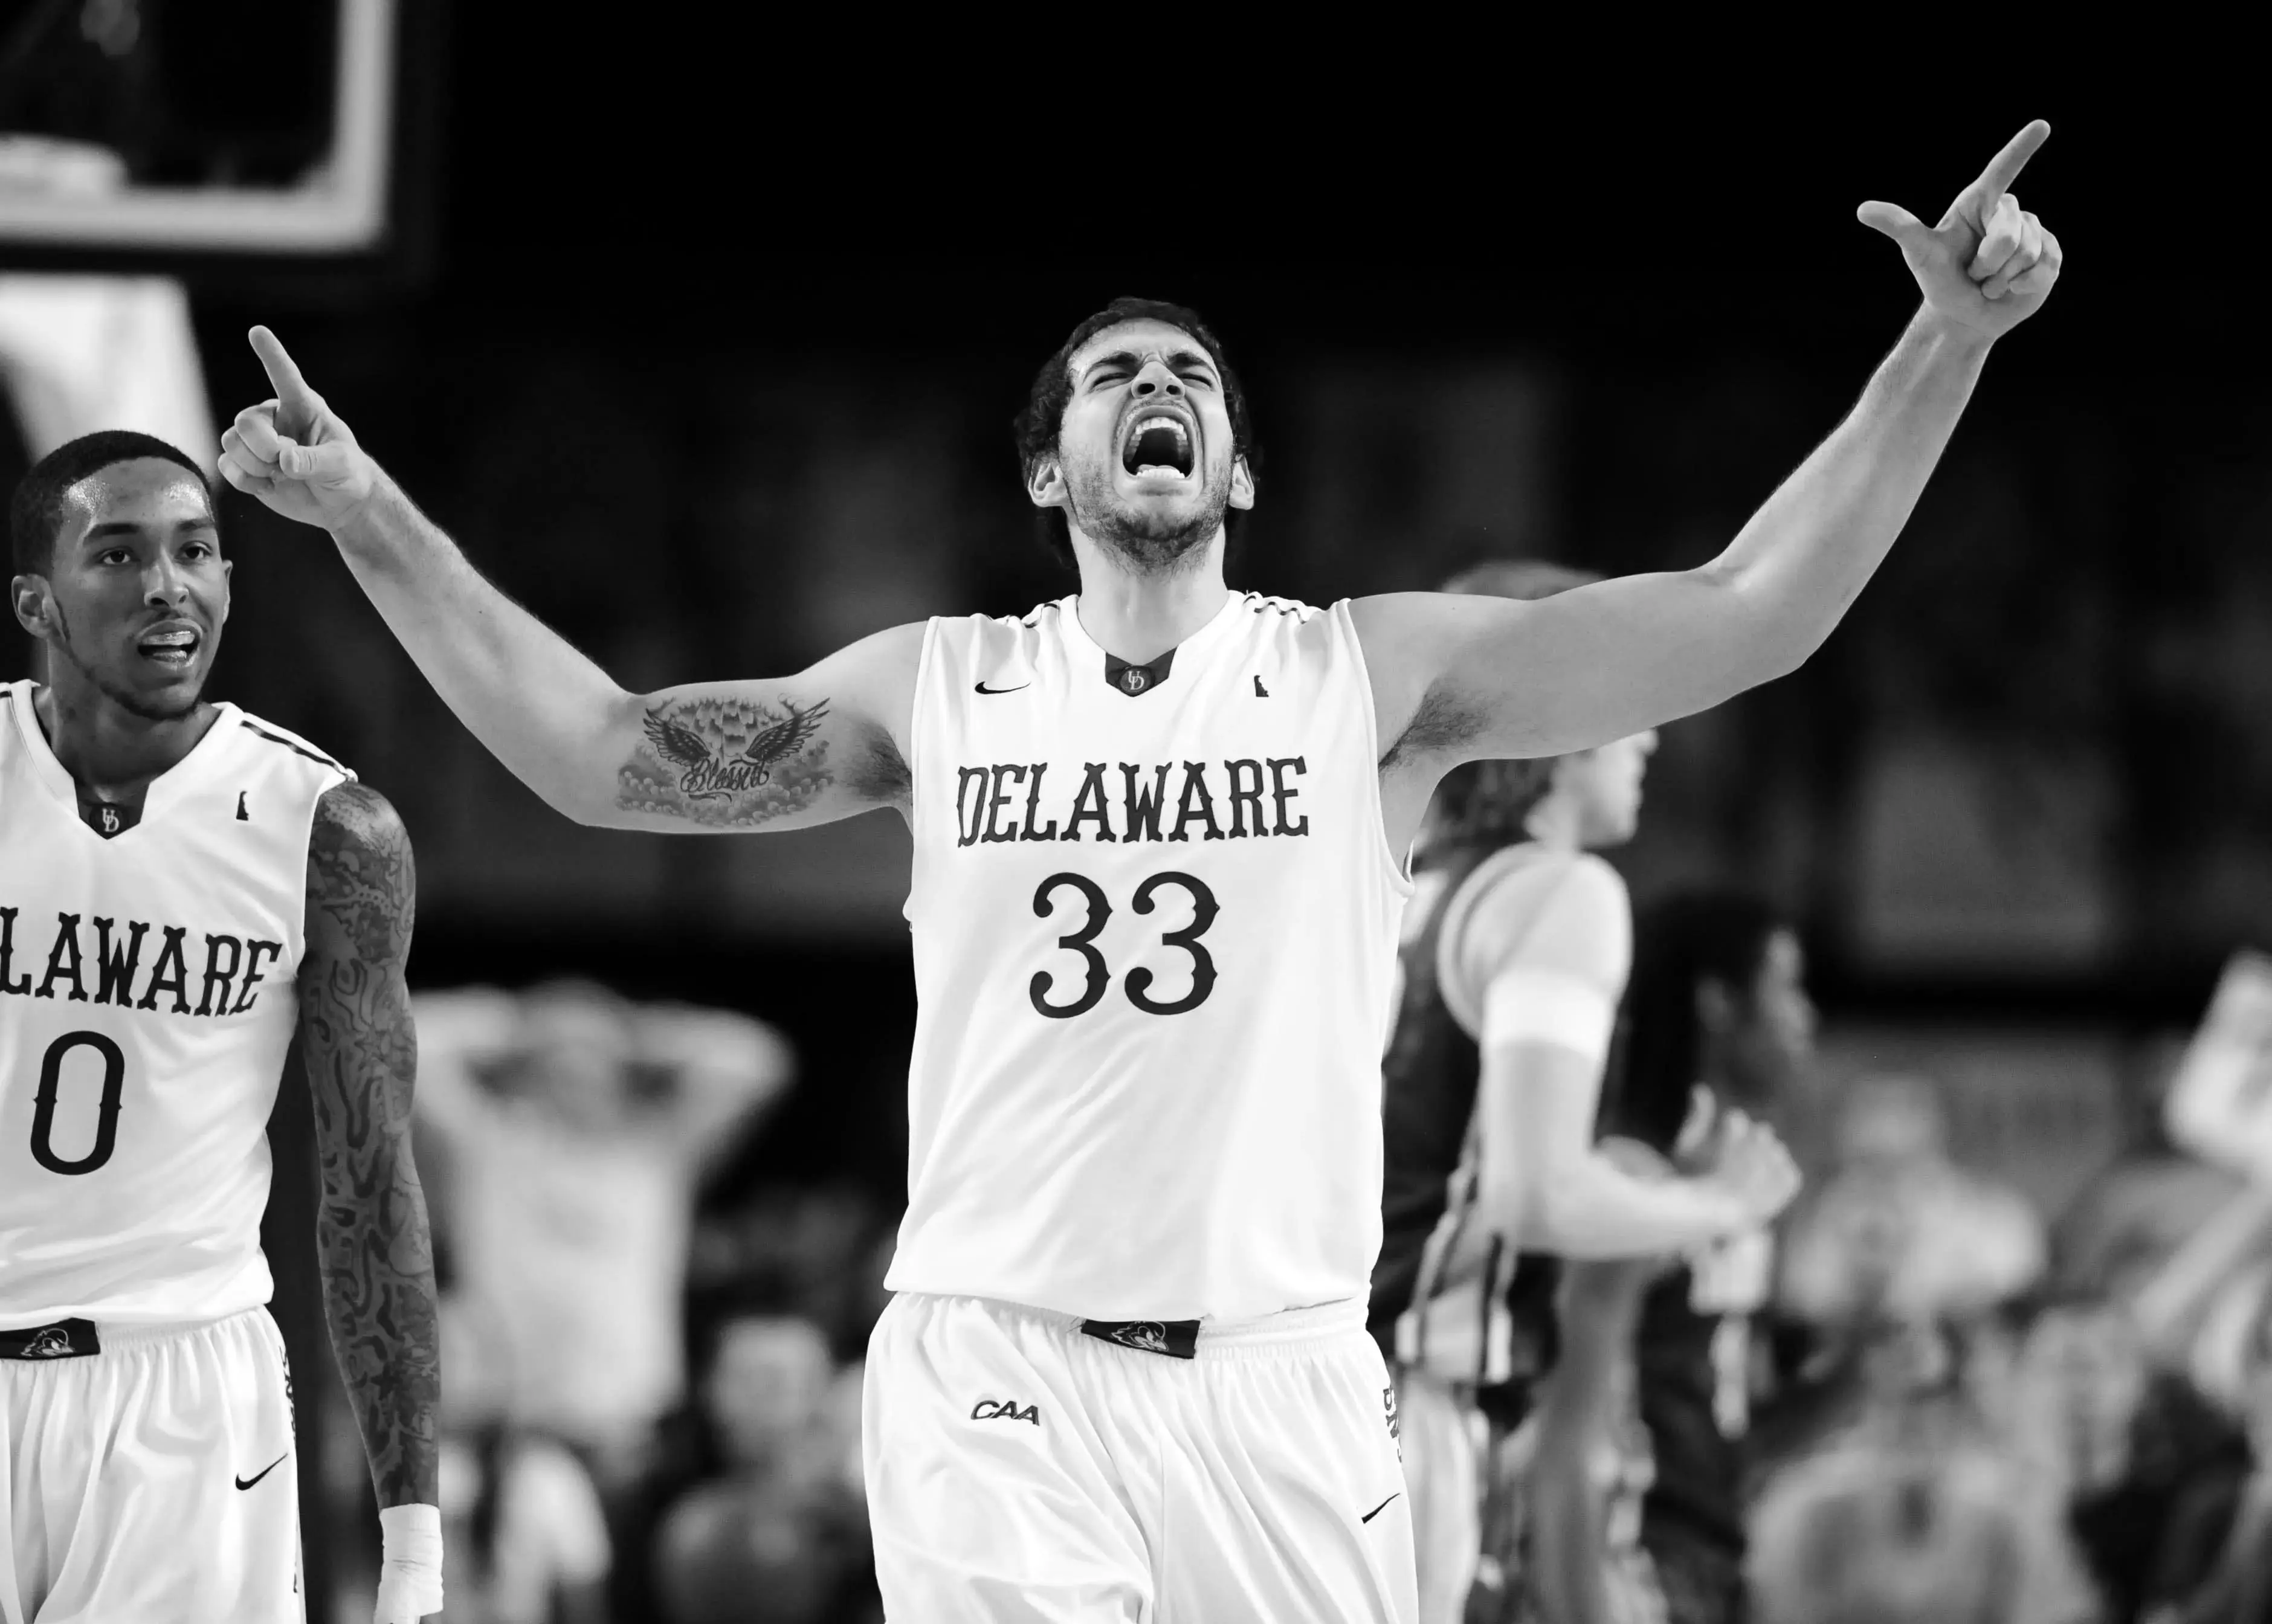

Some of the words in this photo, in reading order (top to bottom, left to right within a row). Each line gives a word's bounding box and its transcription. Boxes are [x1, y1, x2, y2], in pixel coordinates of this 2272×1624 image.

[957, 756, 1309, 848] DELAWARE
[1030, 871, 1221, 1019] 33
[30, 1031, 124, 1175] 0
[970, 1400, 1040, 1426] CAA
